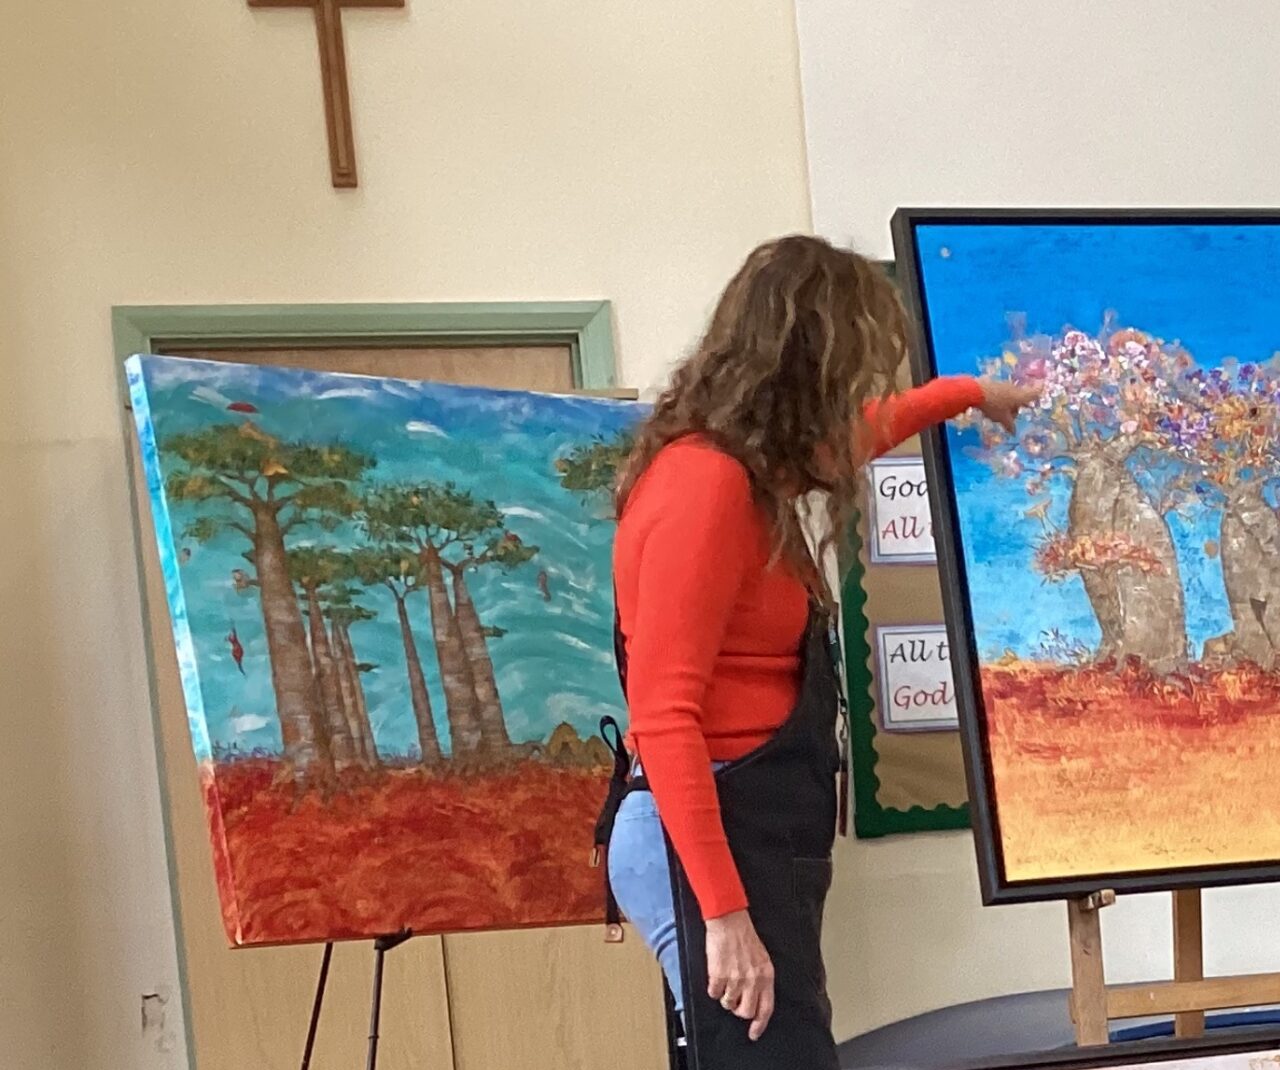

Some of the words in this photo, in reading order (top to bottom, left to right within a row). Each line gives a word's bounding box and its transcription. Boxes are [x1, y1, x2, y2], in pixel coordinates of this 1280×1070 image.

[881, 516, 925, 540] All
[889, 639, 933, 663] All
[893, 681, 954, 710] God
